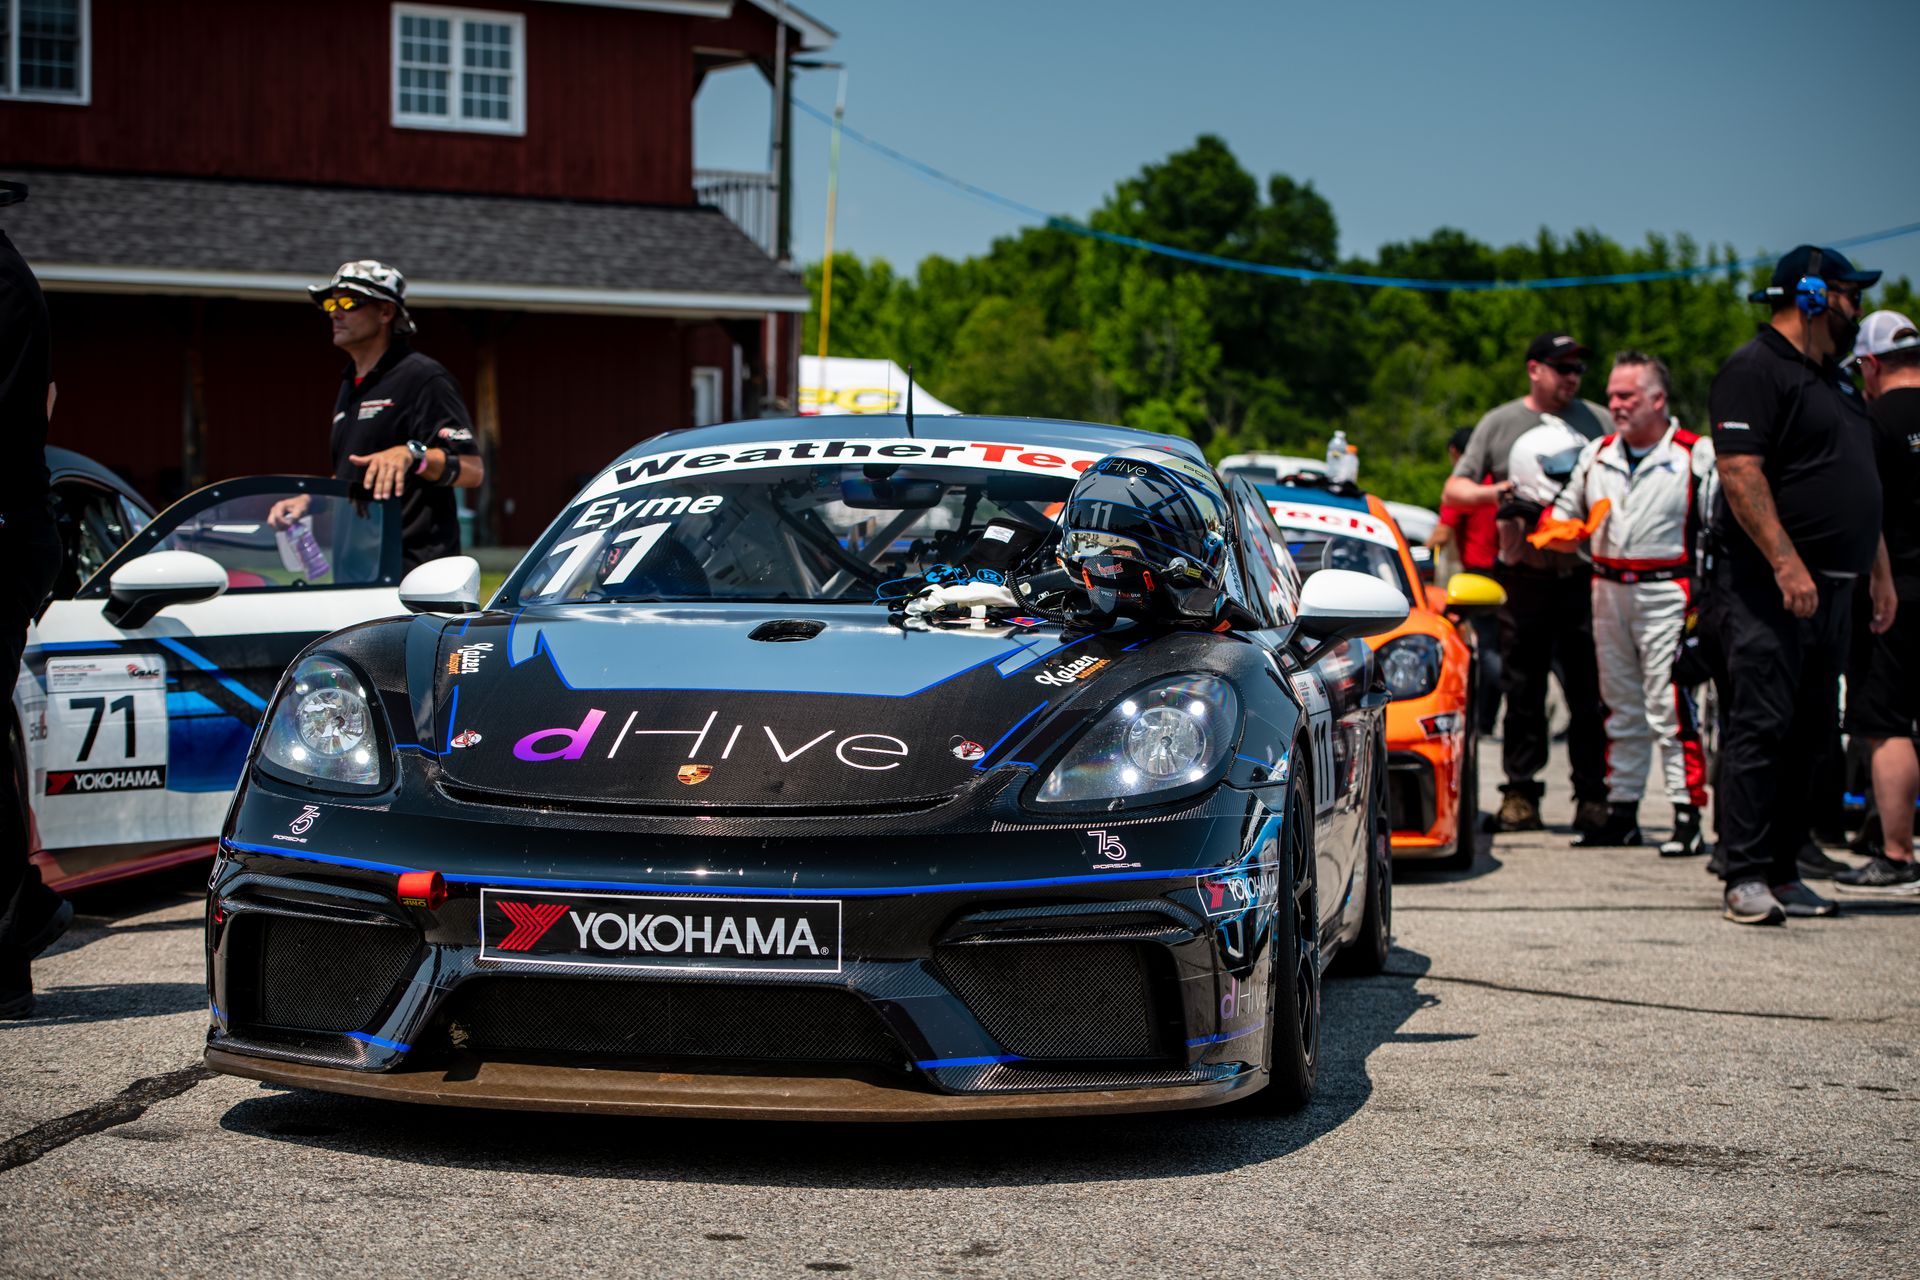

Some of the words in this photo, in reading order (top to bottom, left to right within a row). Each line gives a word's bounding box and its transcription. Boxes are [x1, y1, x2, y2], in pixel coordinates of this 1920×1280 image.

[616, 441, 1097, 485] WeatherTec
[1097, 458, 1148, 477] dHive
[573, 495, 723, 529] Eyme
[1091, 502, 1113, 530] 11
[539, 522, 672, 597] 11
[457, 642, 494, 675] Kaizen
[1034, 655, 1099, 687] Kaizen
[69, 695, 136, 762] 71
[512, 708, 909, 770] dHive
[74, 769, 160, 791] YOKOHAMA
[1087, 830, 1127, 860] 75
[1227, 873, 1279, 902] YOKOHAMA
[569, 911, 820, 955] YOKOHAMA
